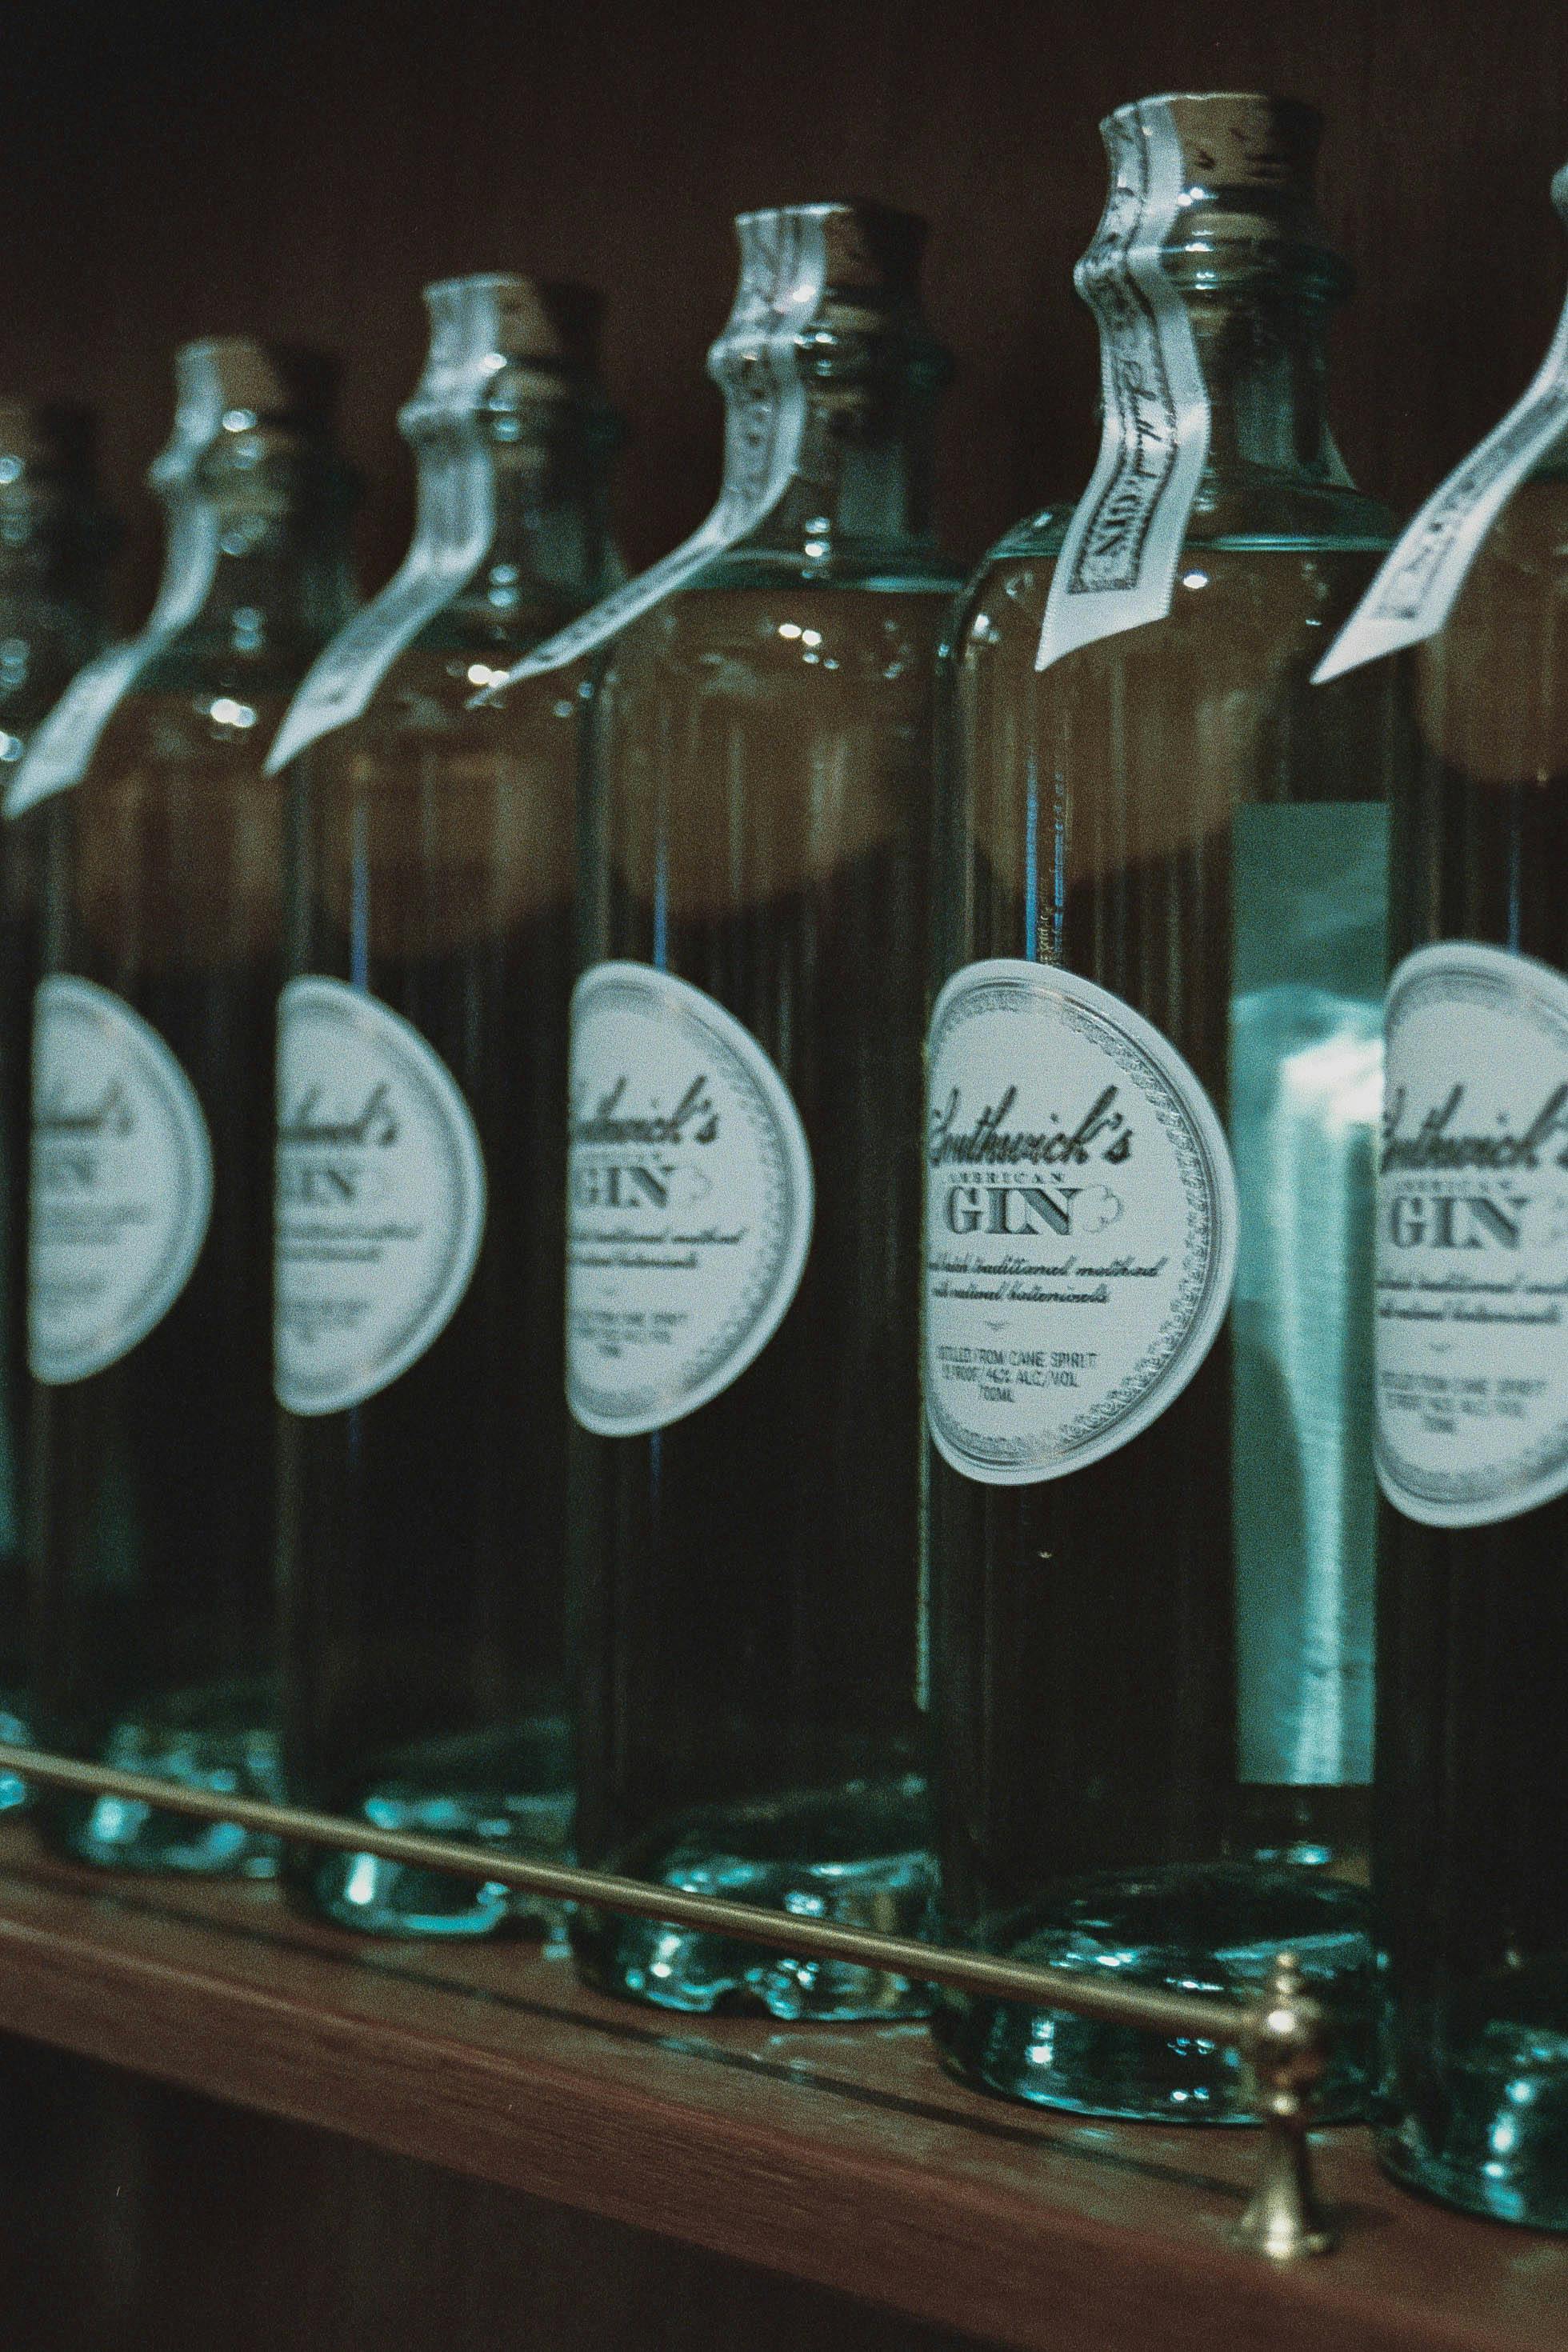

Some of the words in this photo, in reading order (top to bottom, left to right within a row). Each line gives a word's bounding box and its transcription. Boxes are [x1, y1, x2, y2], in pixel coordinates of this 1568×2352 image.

[946, 1187, 1083, 1235] GIN
[1389, 1195, 1530, 1250] GIN
[1009, 1350, 1046, 1368] CANE
[1050, 1351, 1098, 1369] SPIRIT
